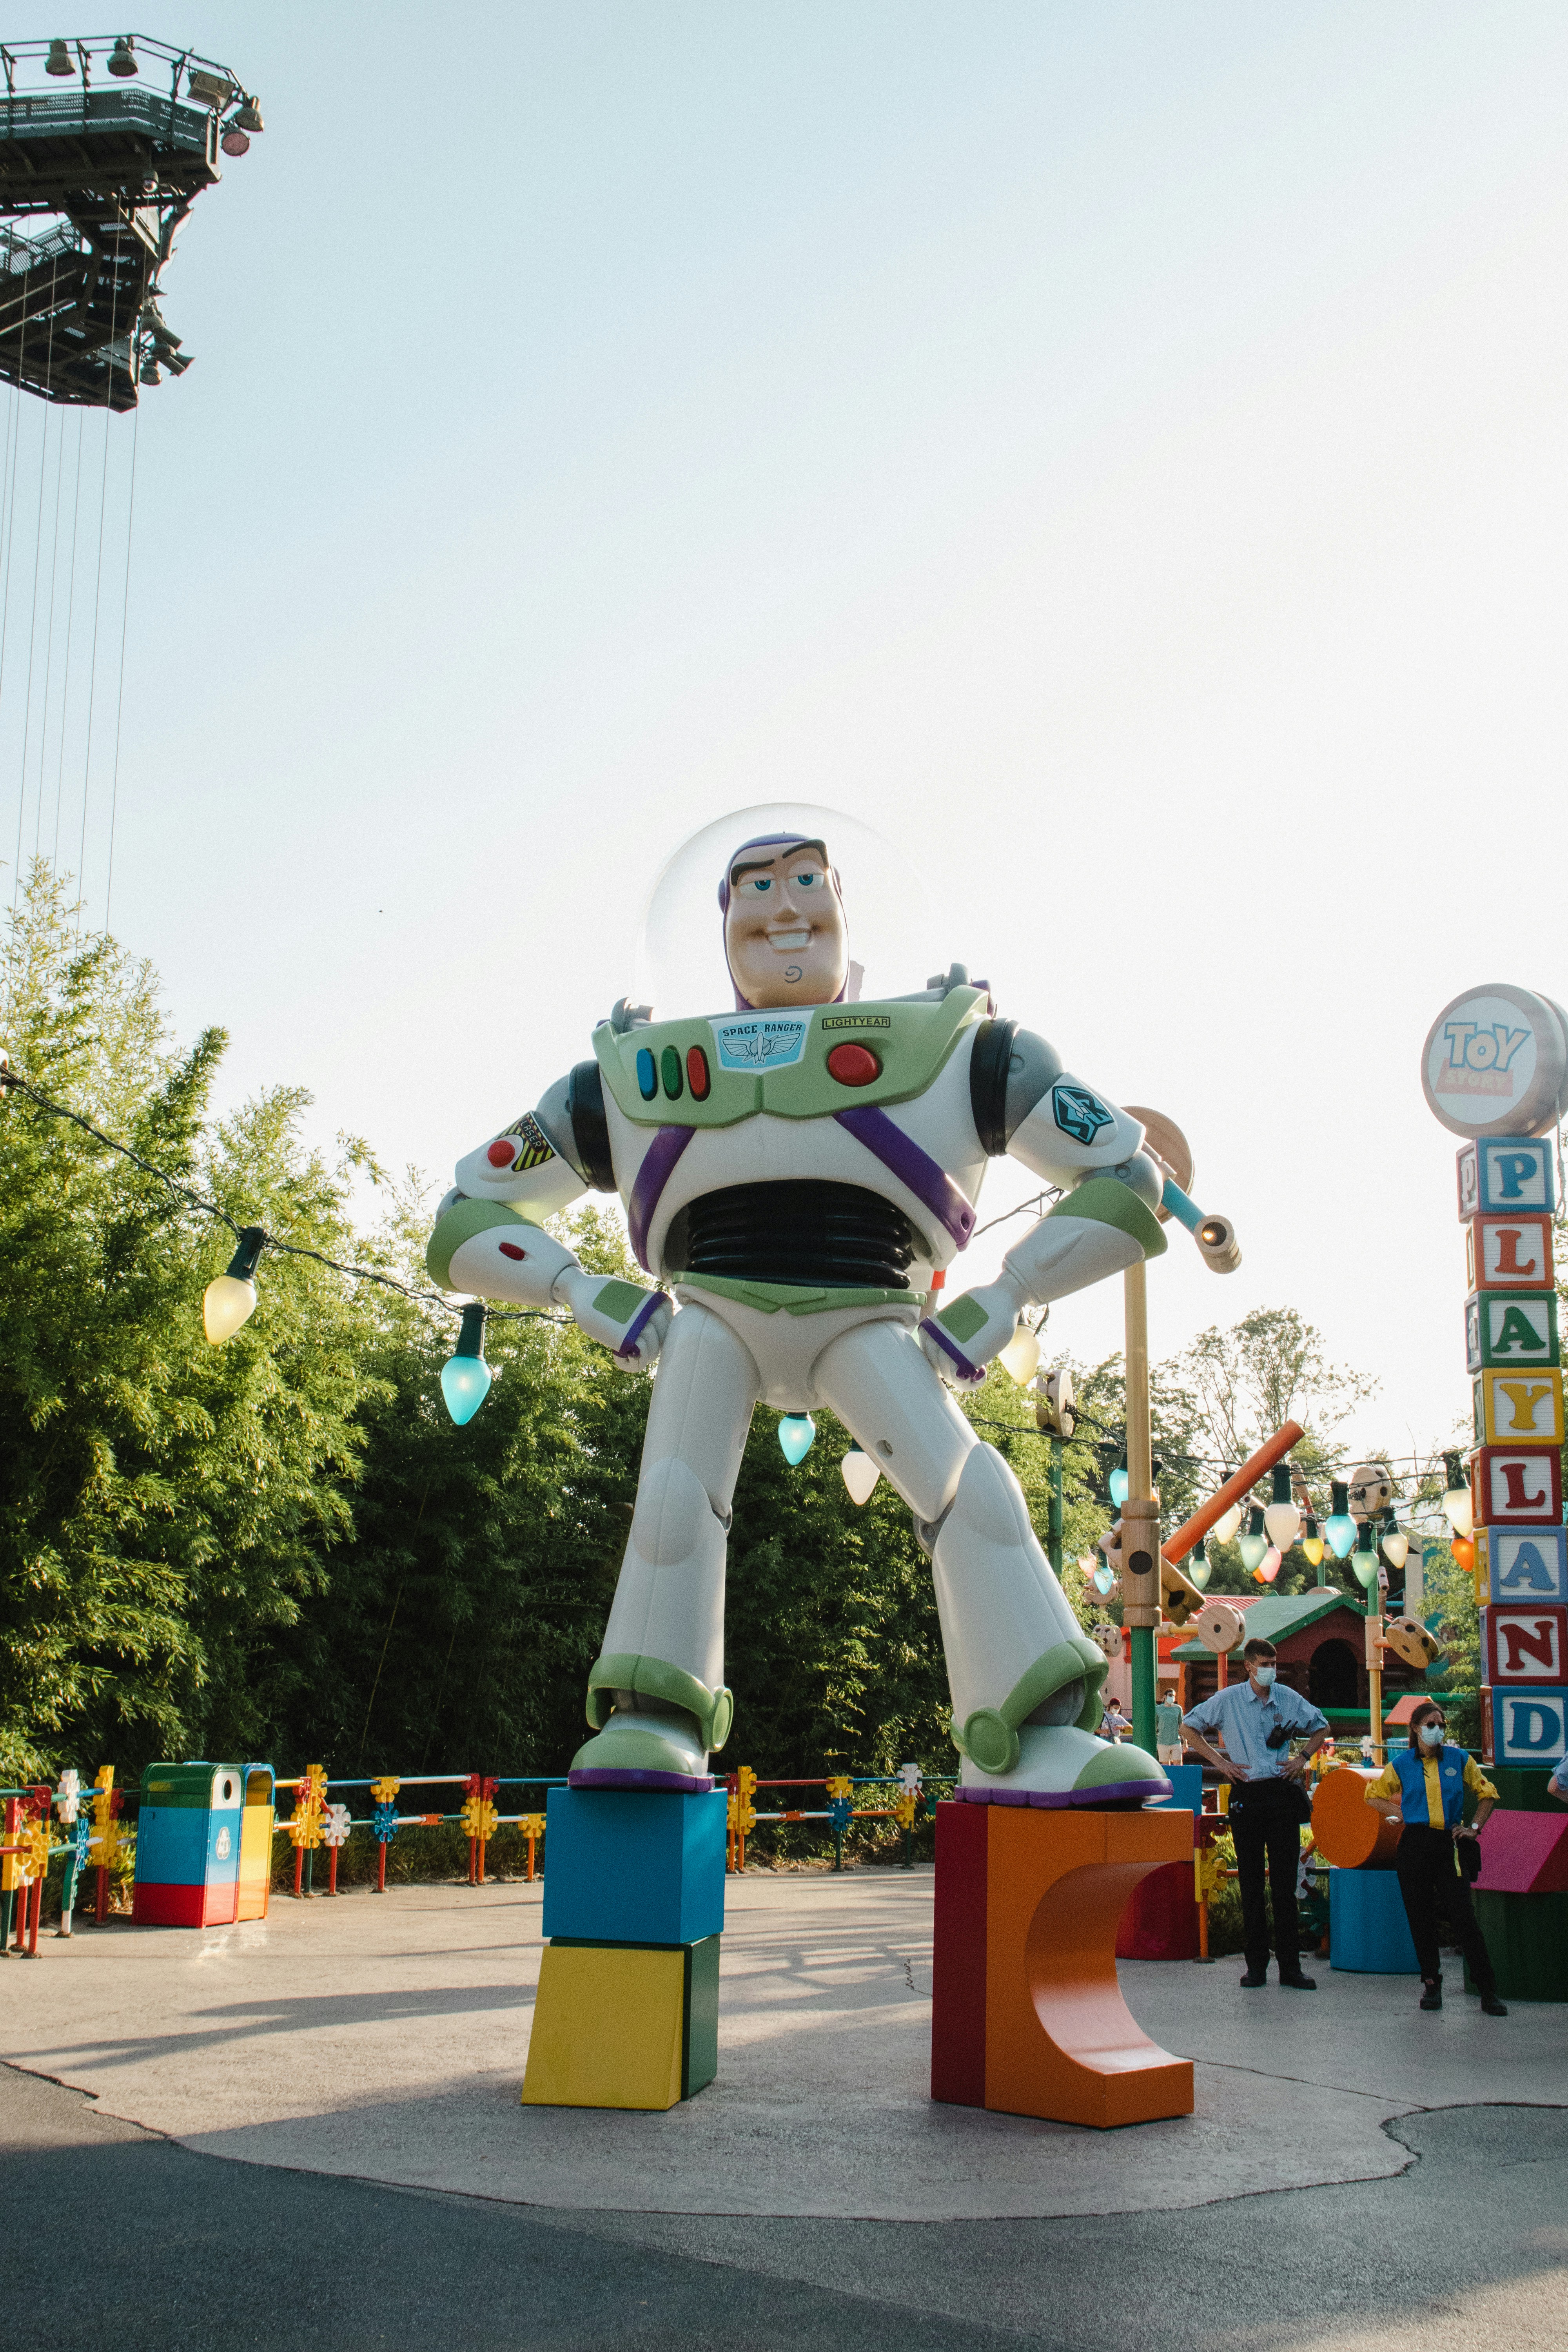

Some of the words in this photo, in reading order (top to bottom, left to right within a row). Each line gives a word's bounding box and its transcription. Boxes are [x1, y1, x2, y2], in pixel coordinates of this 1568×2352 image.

[722, 1025, 758, 1037] SPACE
[764, 1024, 803, 1033] RANGER
[825, 1018, 889, 1028] LIGHTYEAR
[1444, 1022, 1532, 1073] TOY
[1446, 1070, 1508, 1090] STORY
[520, 1120, 542, 1148] LASER
